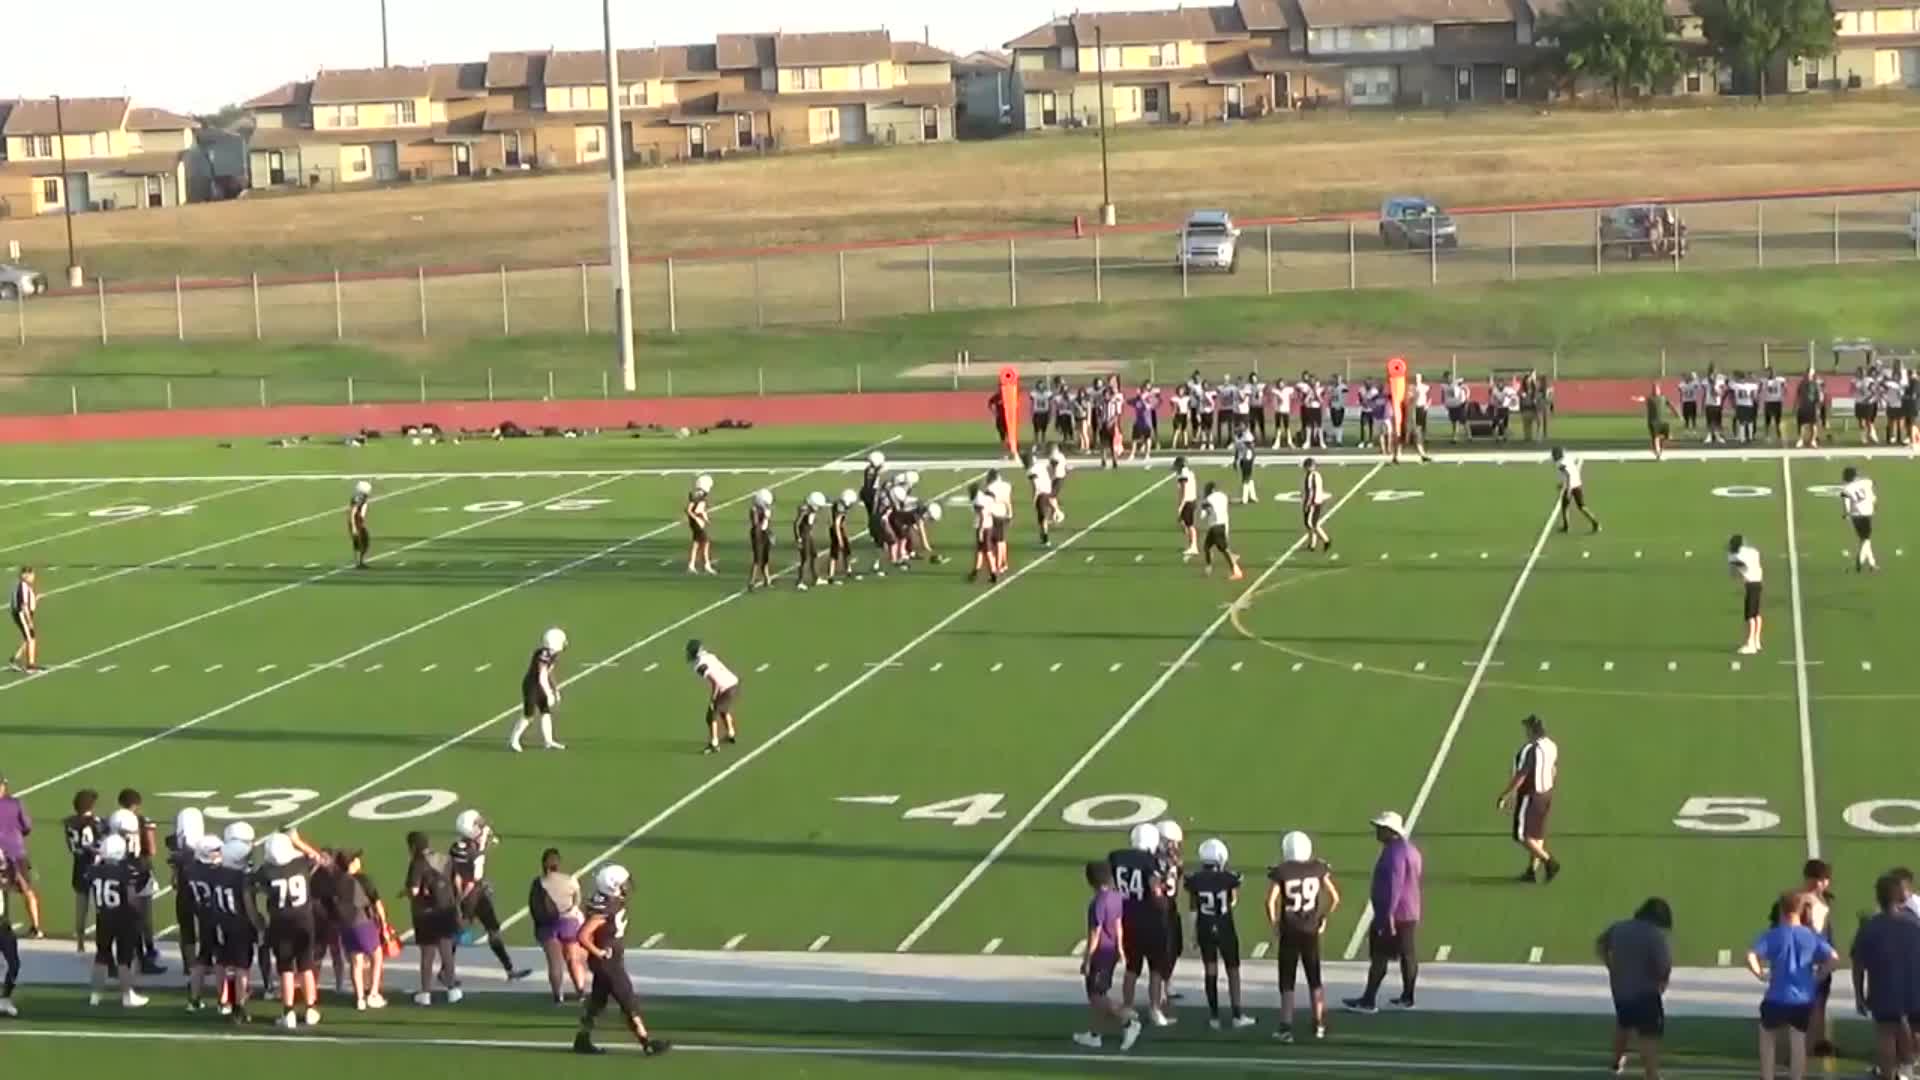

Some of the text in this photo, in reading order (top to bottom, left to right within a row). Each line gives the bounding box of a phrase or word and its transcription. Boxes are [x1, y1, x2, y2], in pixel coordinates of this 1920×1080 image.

[93, 878, 120, 907] 16
[271, 874, 307, 909] 79
[1116, 865, 1144, 901] 64
[1285, 877, 1320, 912] 59
[214, 885, 237, 914] 11
[1199, 890, 1228, 915] 21
